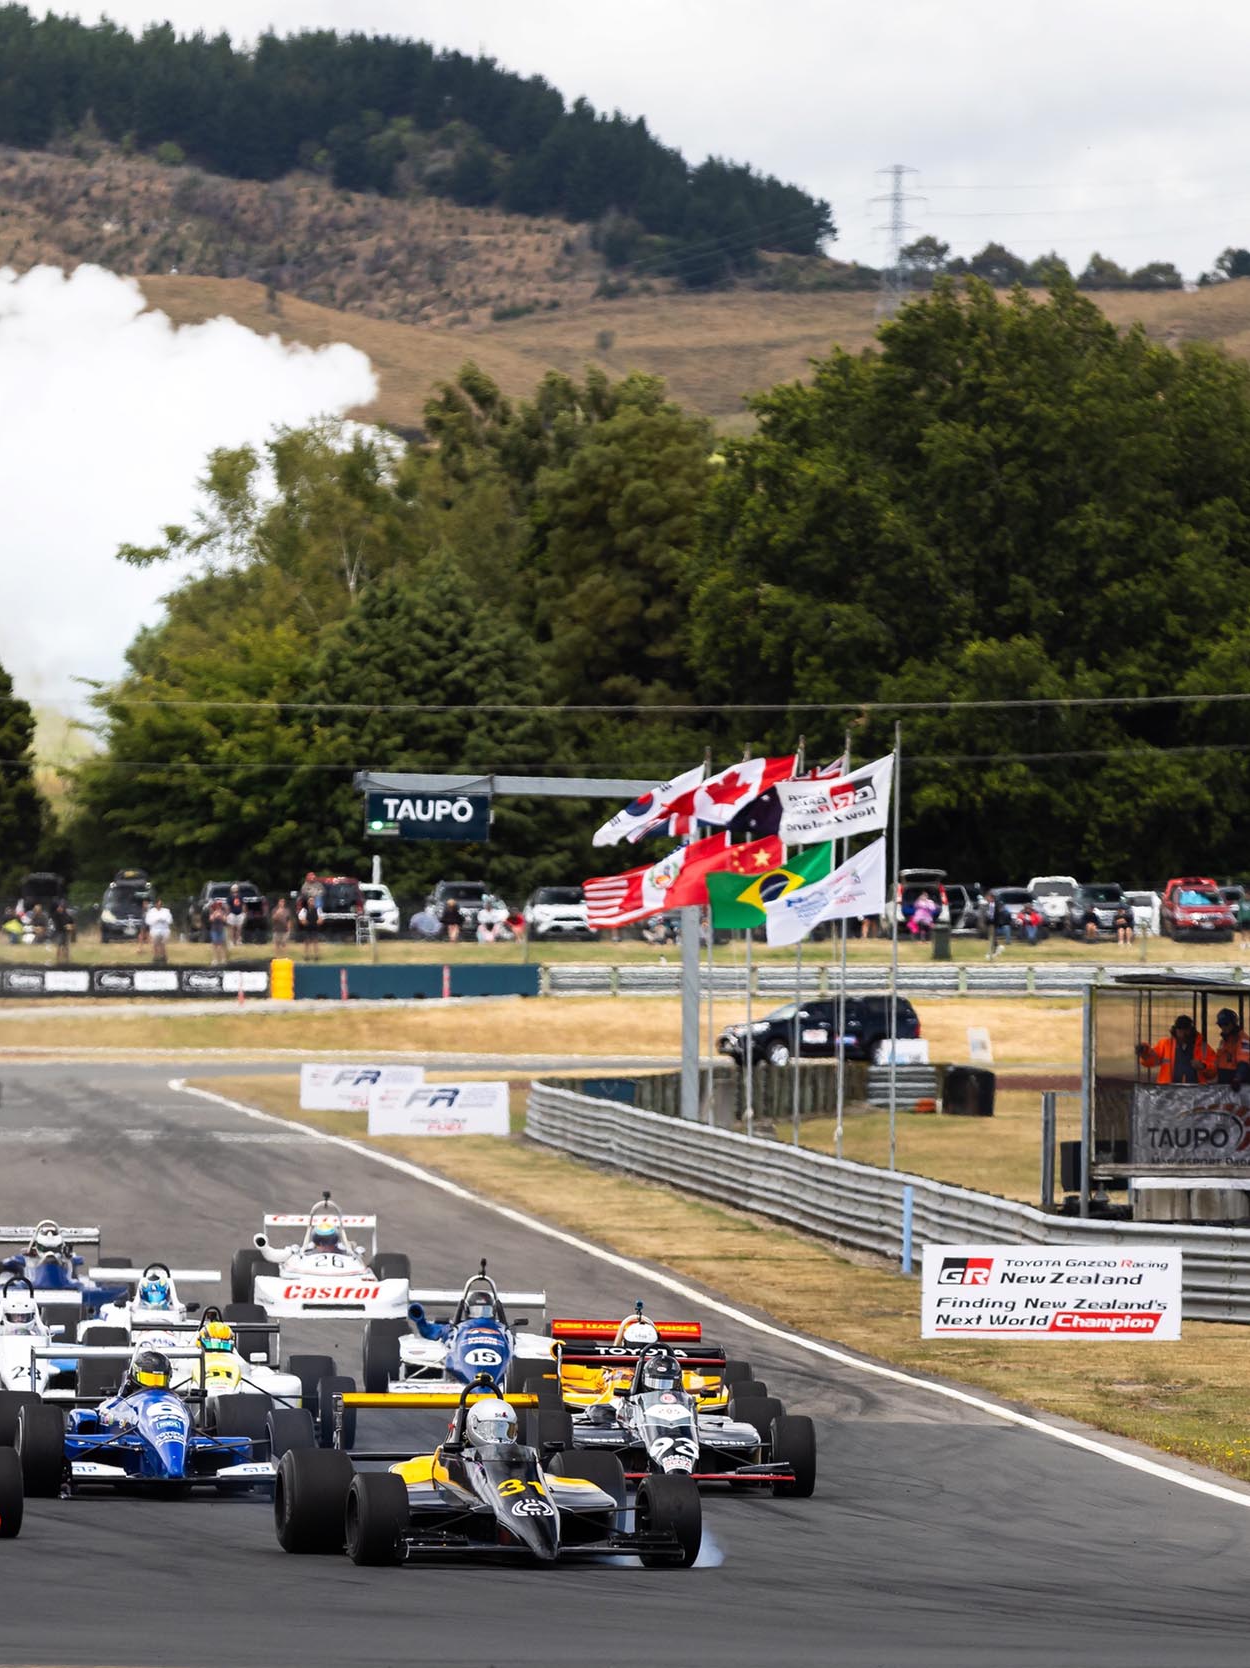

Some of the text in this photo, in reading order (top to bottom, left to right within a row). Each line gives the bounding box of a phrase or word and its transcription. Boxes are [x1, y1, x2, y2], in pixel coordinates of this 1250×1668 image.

[383, 796, 474, 823] TAUPŌ
[315, 1254, 344, 1269] 26
[1005, 1259, 1169, 1272] TOYOTA GAZOO Racing
[1000, 1272, 1143, 1286] New Zealand
[283, 1284, 382, 1300] Castrol
[936, 1297, 1168, 1312] Finding New Zealand's
[935, 1313, 1155, 1331] Next World Champion
[471, 1351, 498, 1363] 15
[595, 1346, 688, 1357] TOYOTA
[649, 1437, 699, 1460] 93
[498, 1478, 546, 1497] 31
